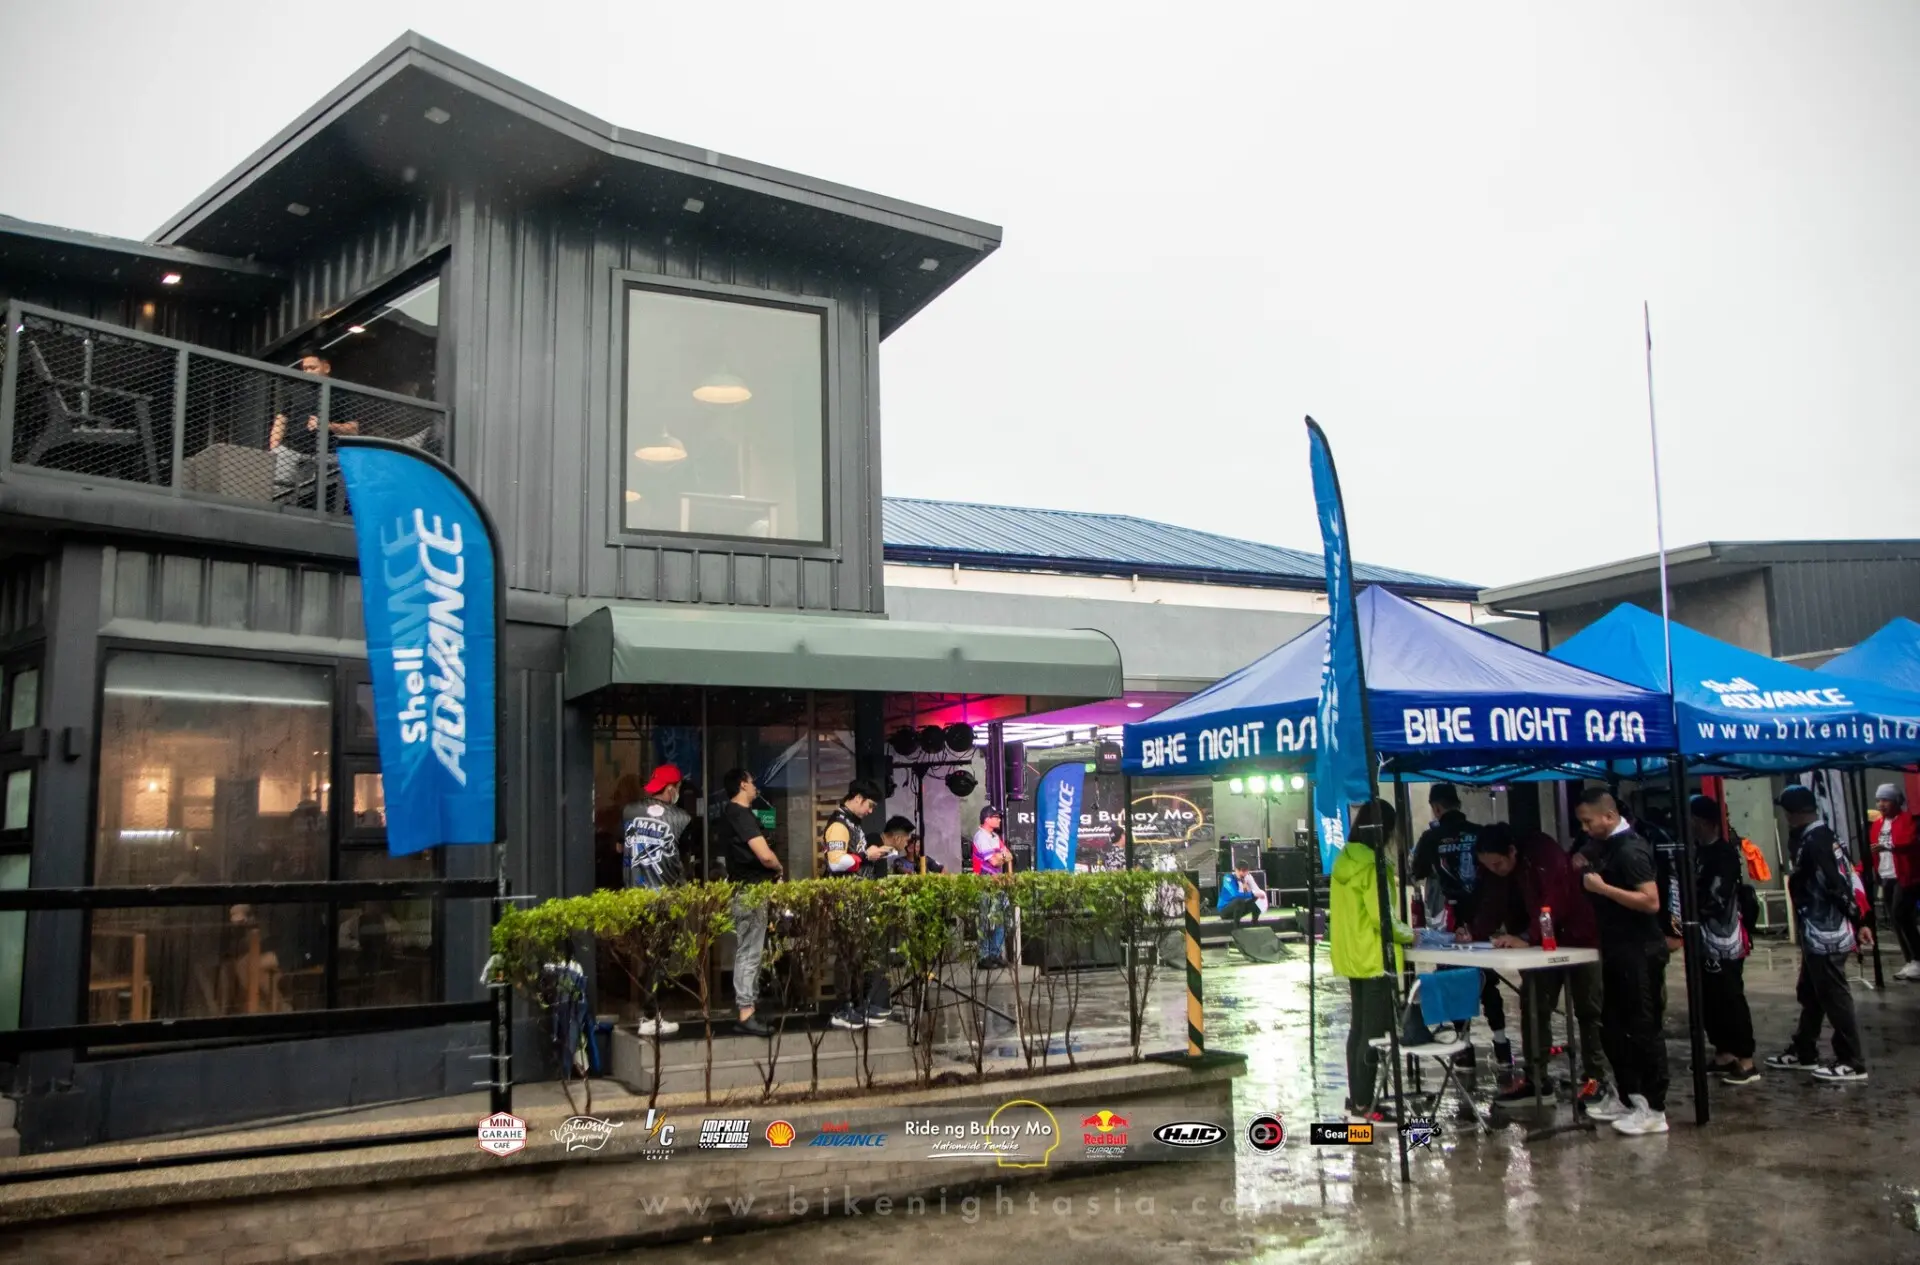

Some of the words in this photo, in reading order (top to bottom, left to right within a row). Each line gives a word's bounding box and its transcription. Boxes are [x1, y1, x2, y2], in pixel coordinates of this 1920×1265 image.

[413, 508, 467, 787] ADVANCE
[392, 648, 427, 744] Shell
[1720, 687, 1854, 709] ADVANCE
[1142, 733, 1187, 769] BIKE
[1198, 721, 1264, 761] NIGHT
[1276, 715, 1318, 752] ASI
[1403, 707, 1475, 745] BIKE
[1490, 707, 1572, 742] NIGHT
[1584, 709, 1646, 743] ASIA
[637, 820, 665, 834] MAC
[1055, 780, 1075, 868] ADVANCE
[1164, 808, 1193, 820] Mo
[1045, 821, 1056, 850] Shell
